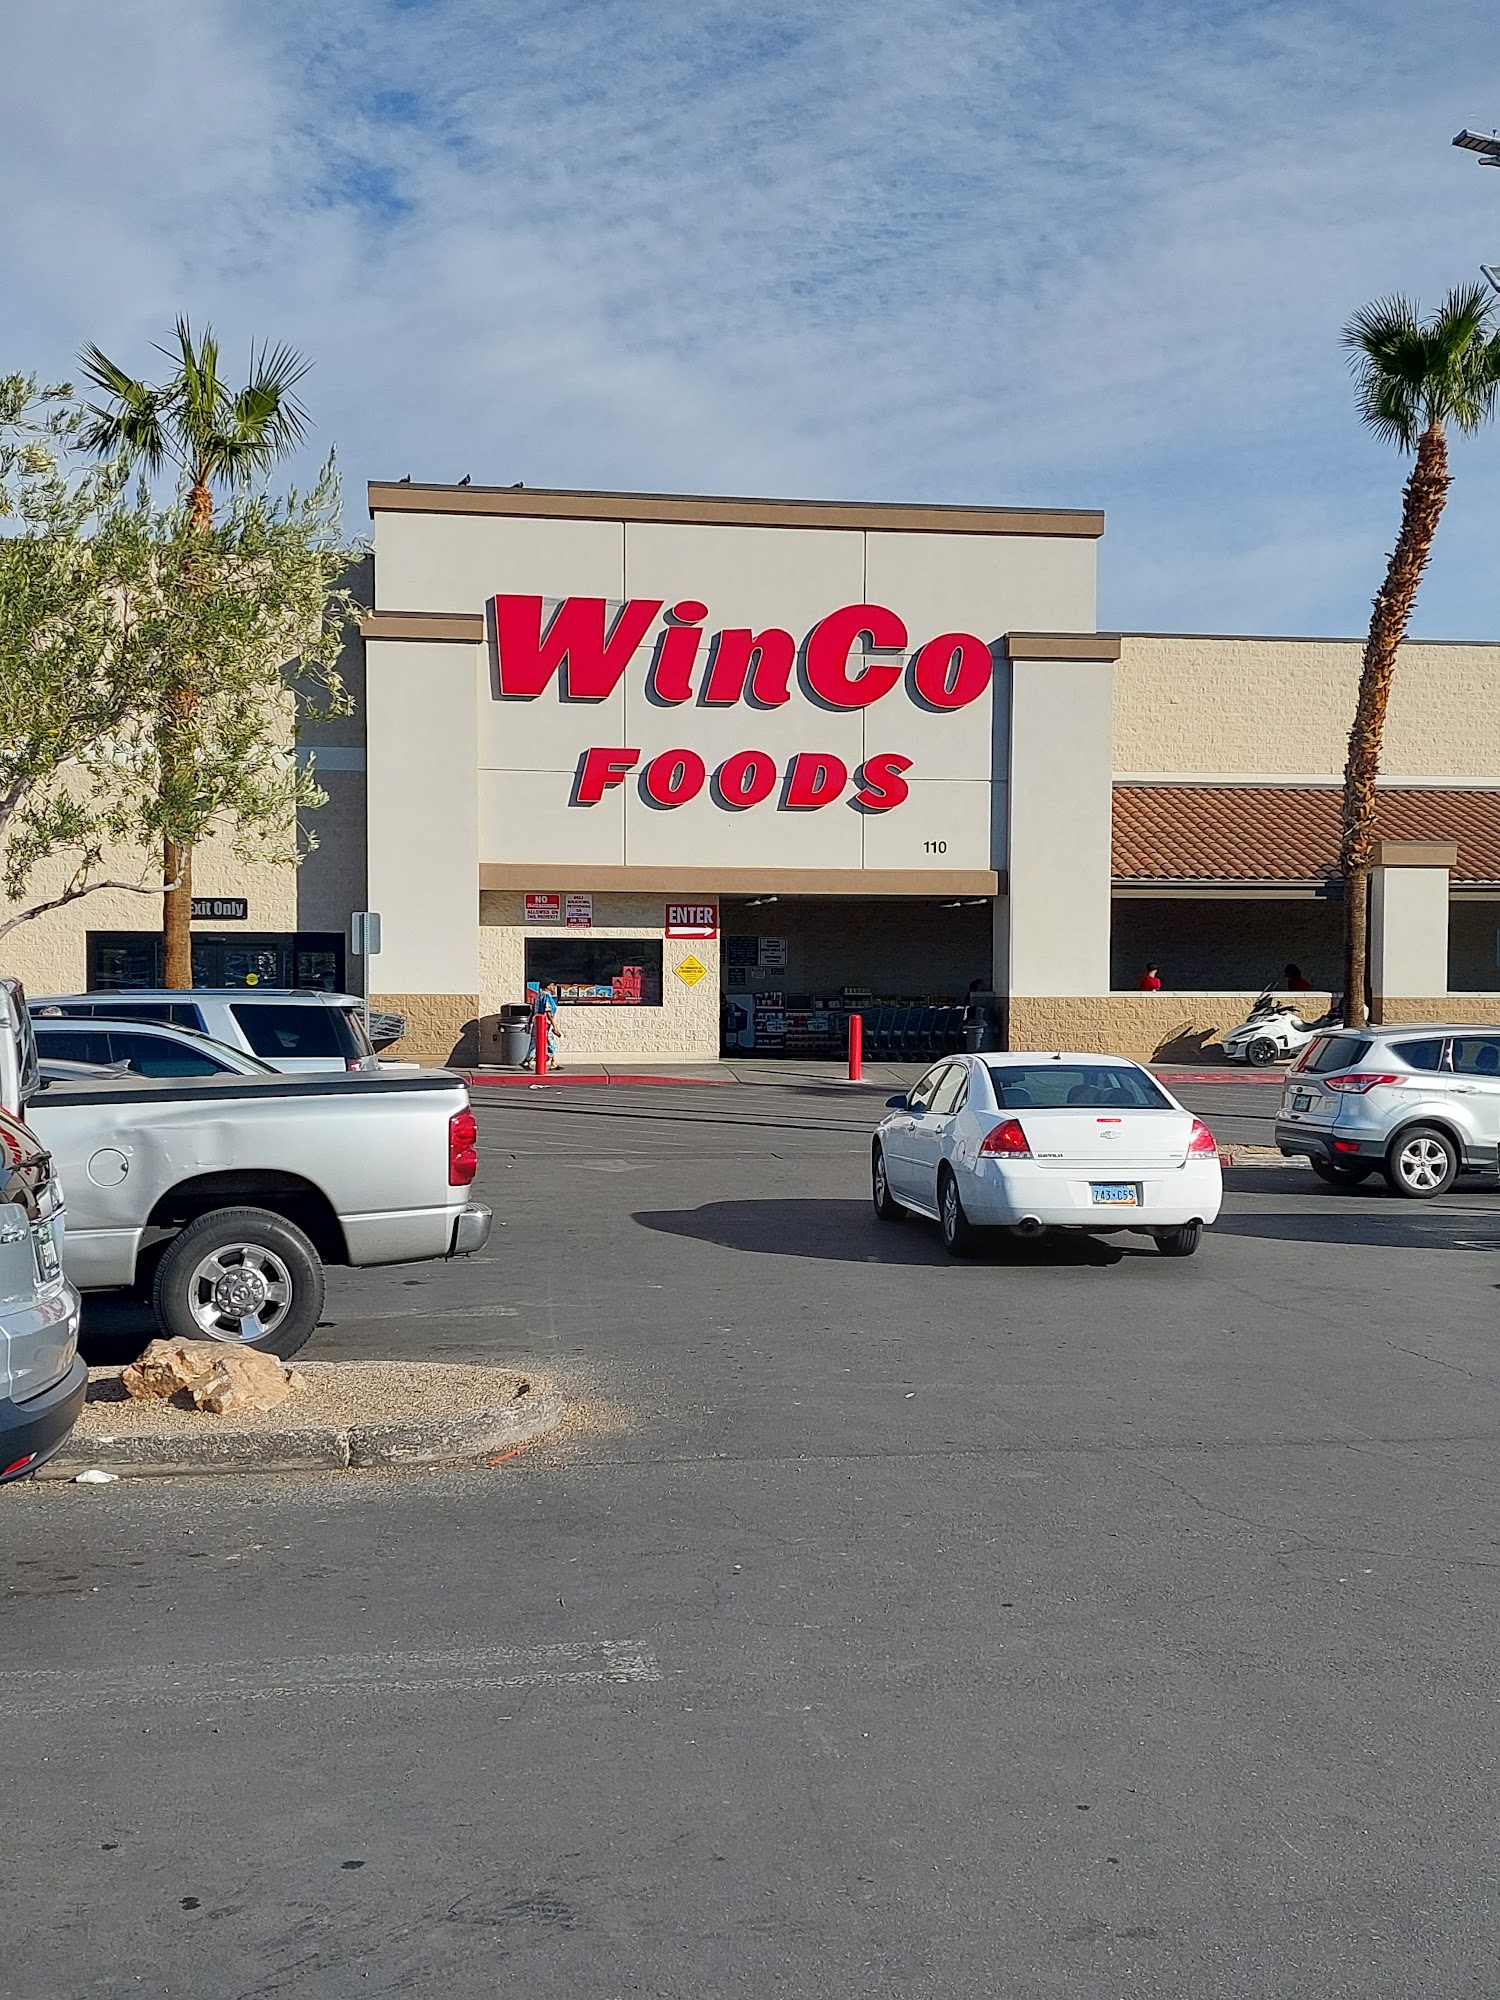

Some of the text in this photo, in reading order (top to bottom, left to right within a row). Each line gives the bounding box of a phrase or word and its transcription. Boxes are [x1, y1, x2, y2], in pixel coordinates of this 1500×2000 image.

[486, 593, 993, 713] WinCo
[568, 747, 914, 815] FOODS
[923, 840, 947, 854] 110
[214, 901, 244, 916] Only
[669, 907, 714, 924] ENTER
